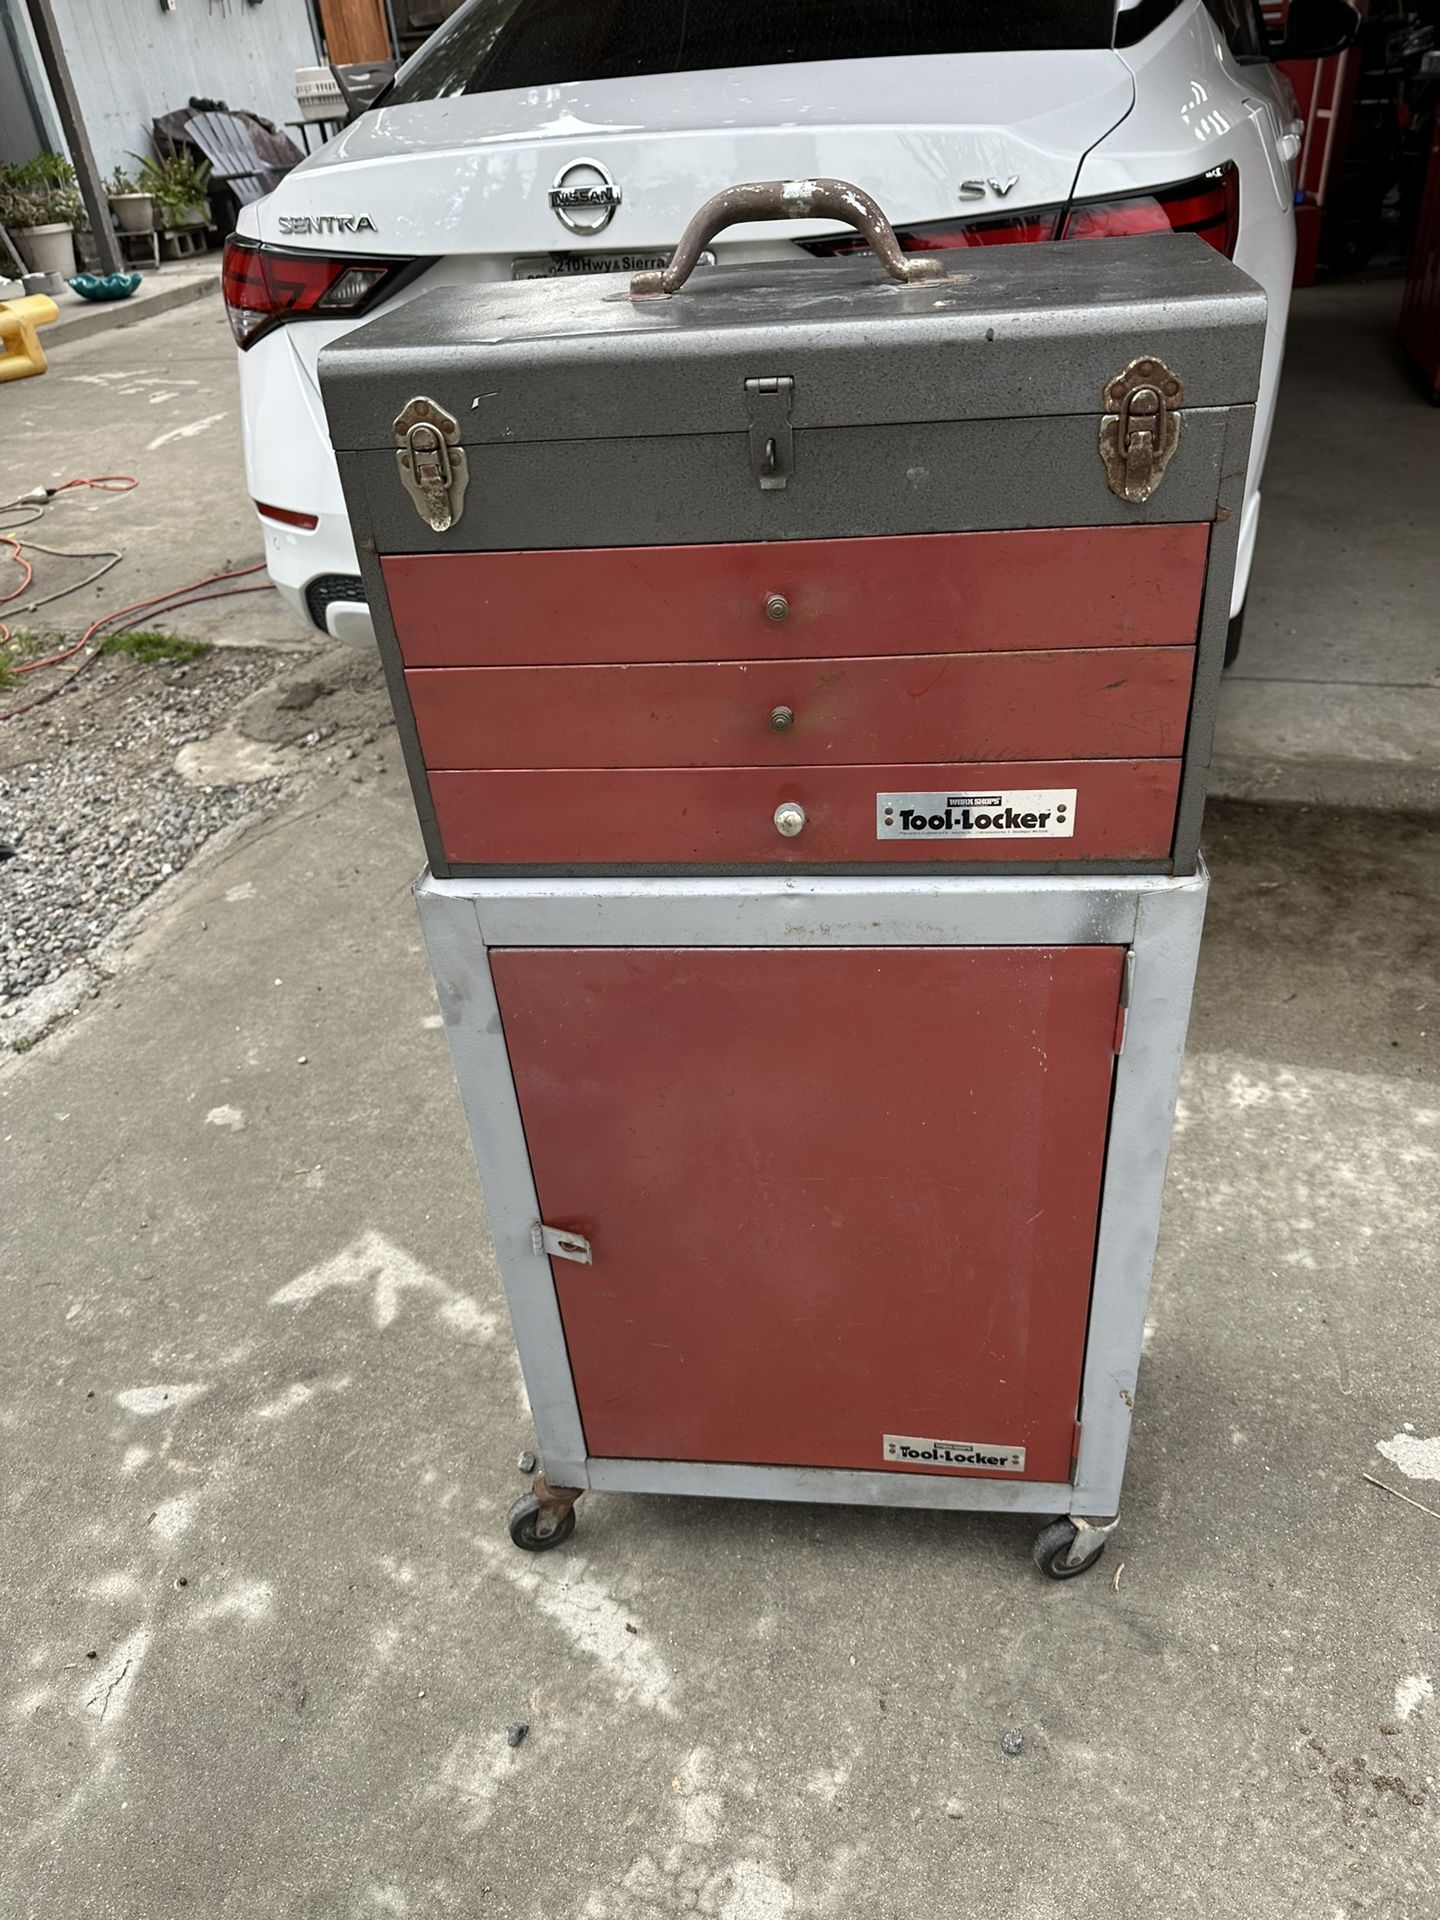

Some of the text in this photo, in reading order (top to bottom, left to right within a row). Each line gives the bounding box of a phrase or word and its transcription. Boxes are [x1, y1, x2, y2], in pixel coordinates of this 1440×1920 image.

[554, 188, 613, 204] NISSAN
[959, 175, 1020, 201] SV
[278, 212, 379, 235] SENTRA
[899, 808, 1051, 831] Tool-Locker
[900, 1446, 1009, 1466] Tool-Locker
